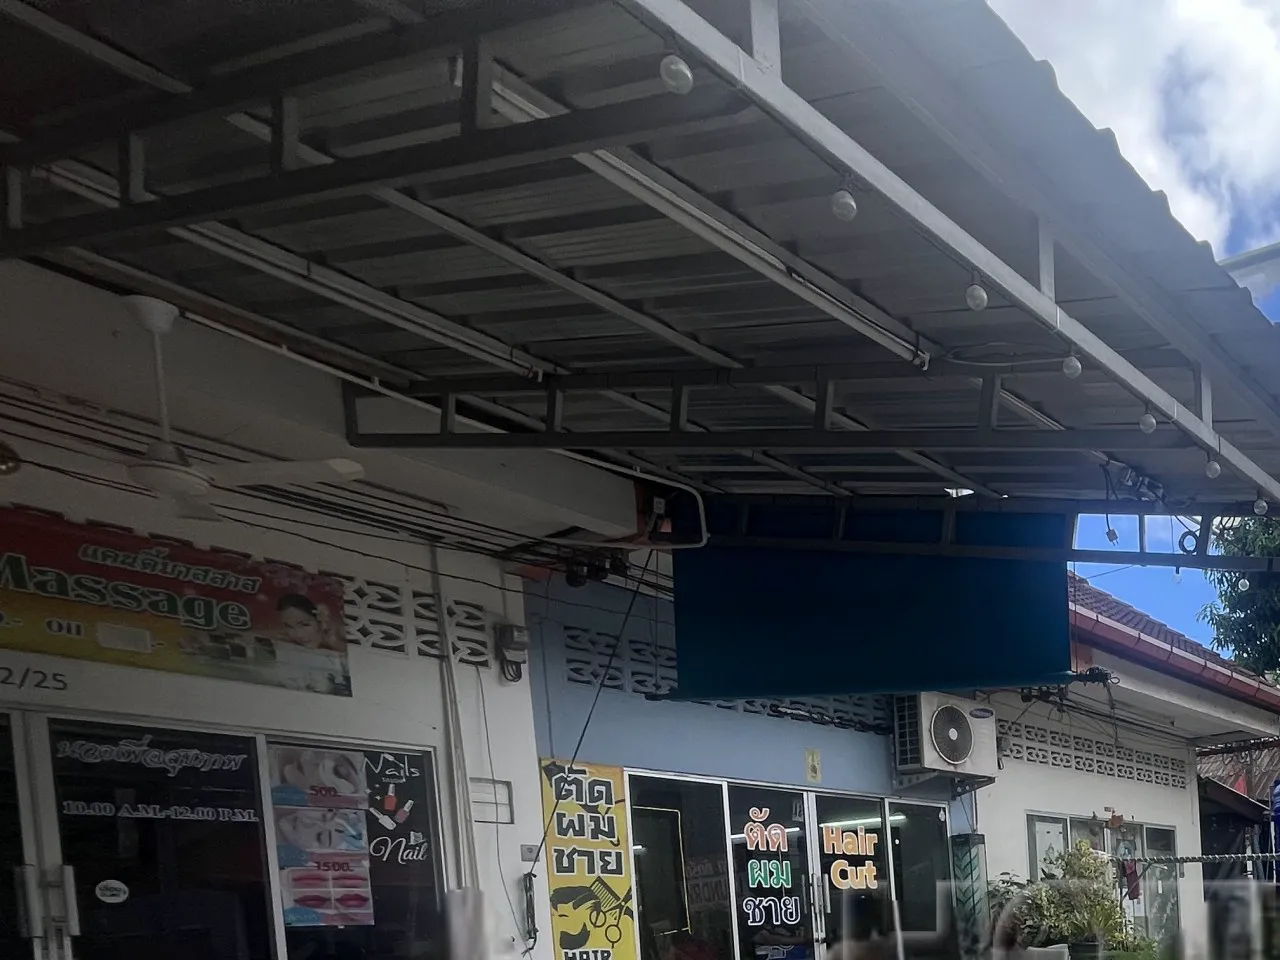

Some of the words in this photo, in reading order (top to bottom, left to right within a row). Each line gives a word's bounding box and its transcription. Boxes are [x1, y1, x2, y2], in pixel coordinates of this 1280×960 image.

[363, 753, 421, 777] Nails
[552, 766, 616, 807] ตัด
[555, 811, 618, 843] ผม
[745, 807, 788, 852] ตัด
[822, 825, 878, 856] Hair
[370, 836, 429, 865] Nail
[553, 845, 624, 877] ชาย
[747, 859, 793, 889] ผม
[829, 859, 878, 889] Cut
[743, 896, 800, 926] ชาย
